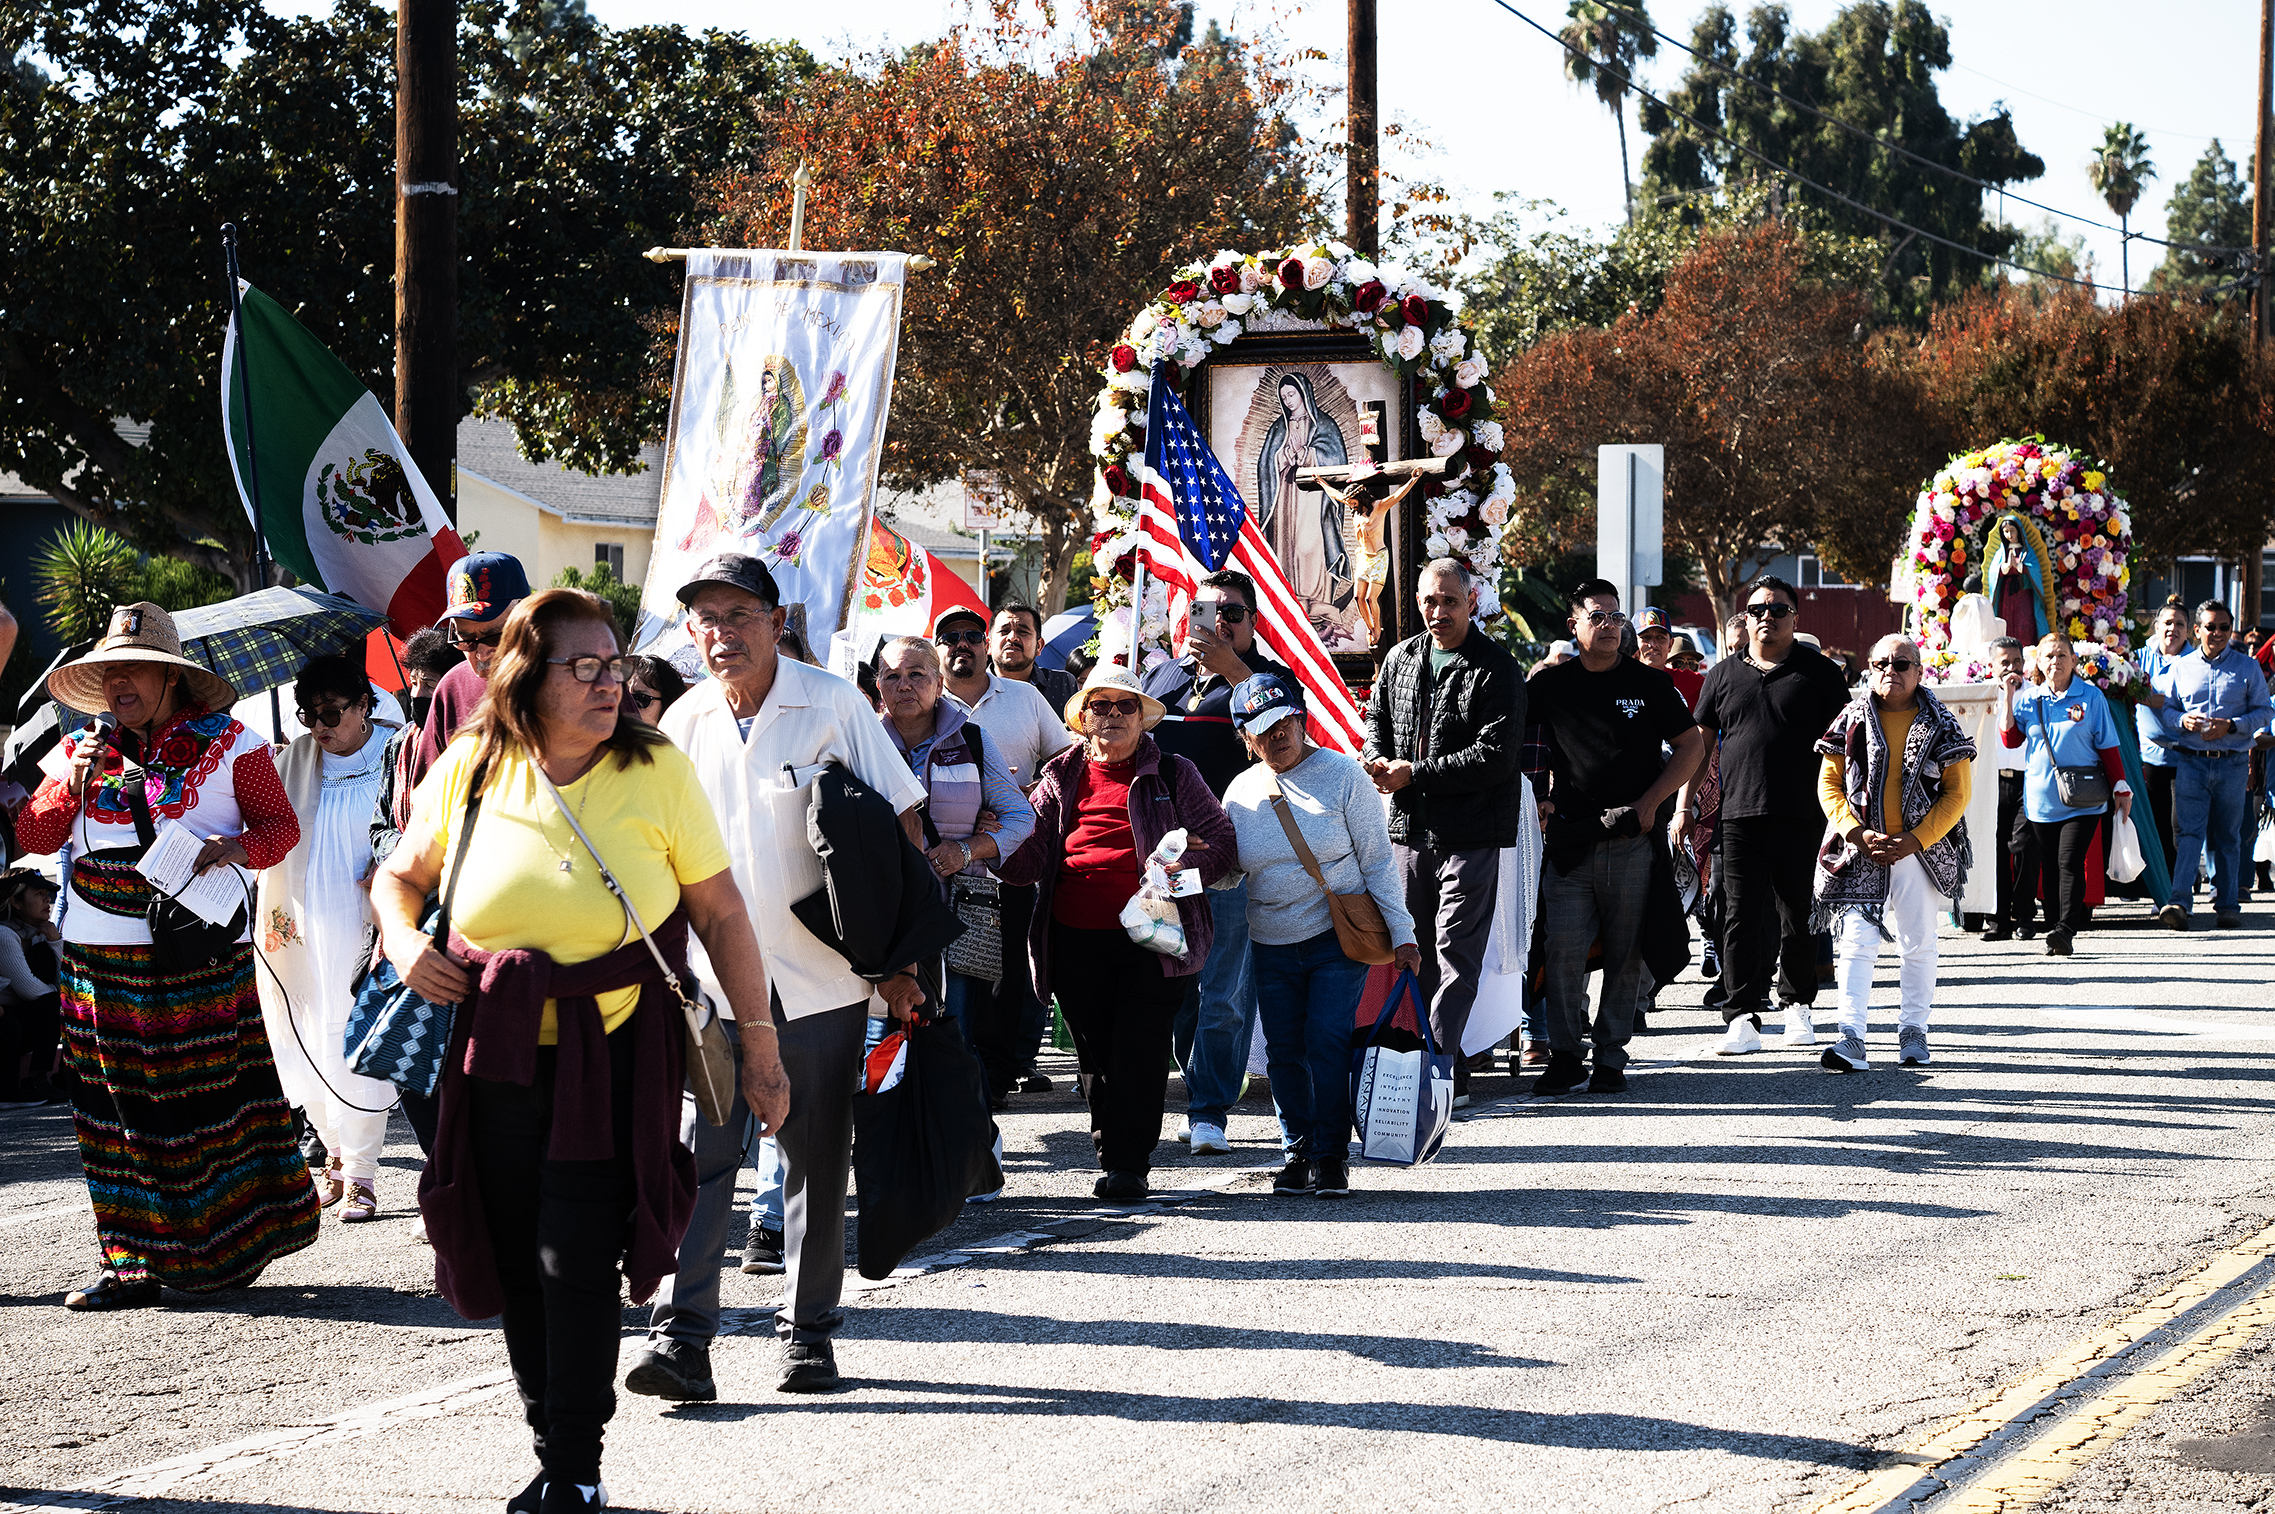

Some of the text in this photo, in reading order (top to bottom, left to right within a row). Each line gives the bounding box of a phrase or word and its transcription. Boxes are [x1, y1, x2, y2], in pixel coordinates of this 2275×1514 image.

[774, 301, 789, 317] DE
[803, 308, 855, 351] MEXICO
[1243, 687, 1284, 714] MEXICO
[1616, 699, 1646, 707] PRADA
[1382, 1073, 1413, 1081] EXCELLENCE
[1380, 1084, 1412, 1092] INTEGRITY
[1376, 1107, 1410, 1115] INNOVATION
